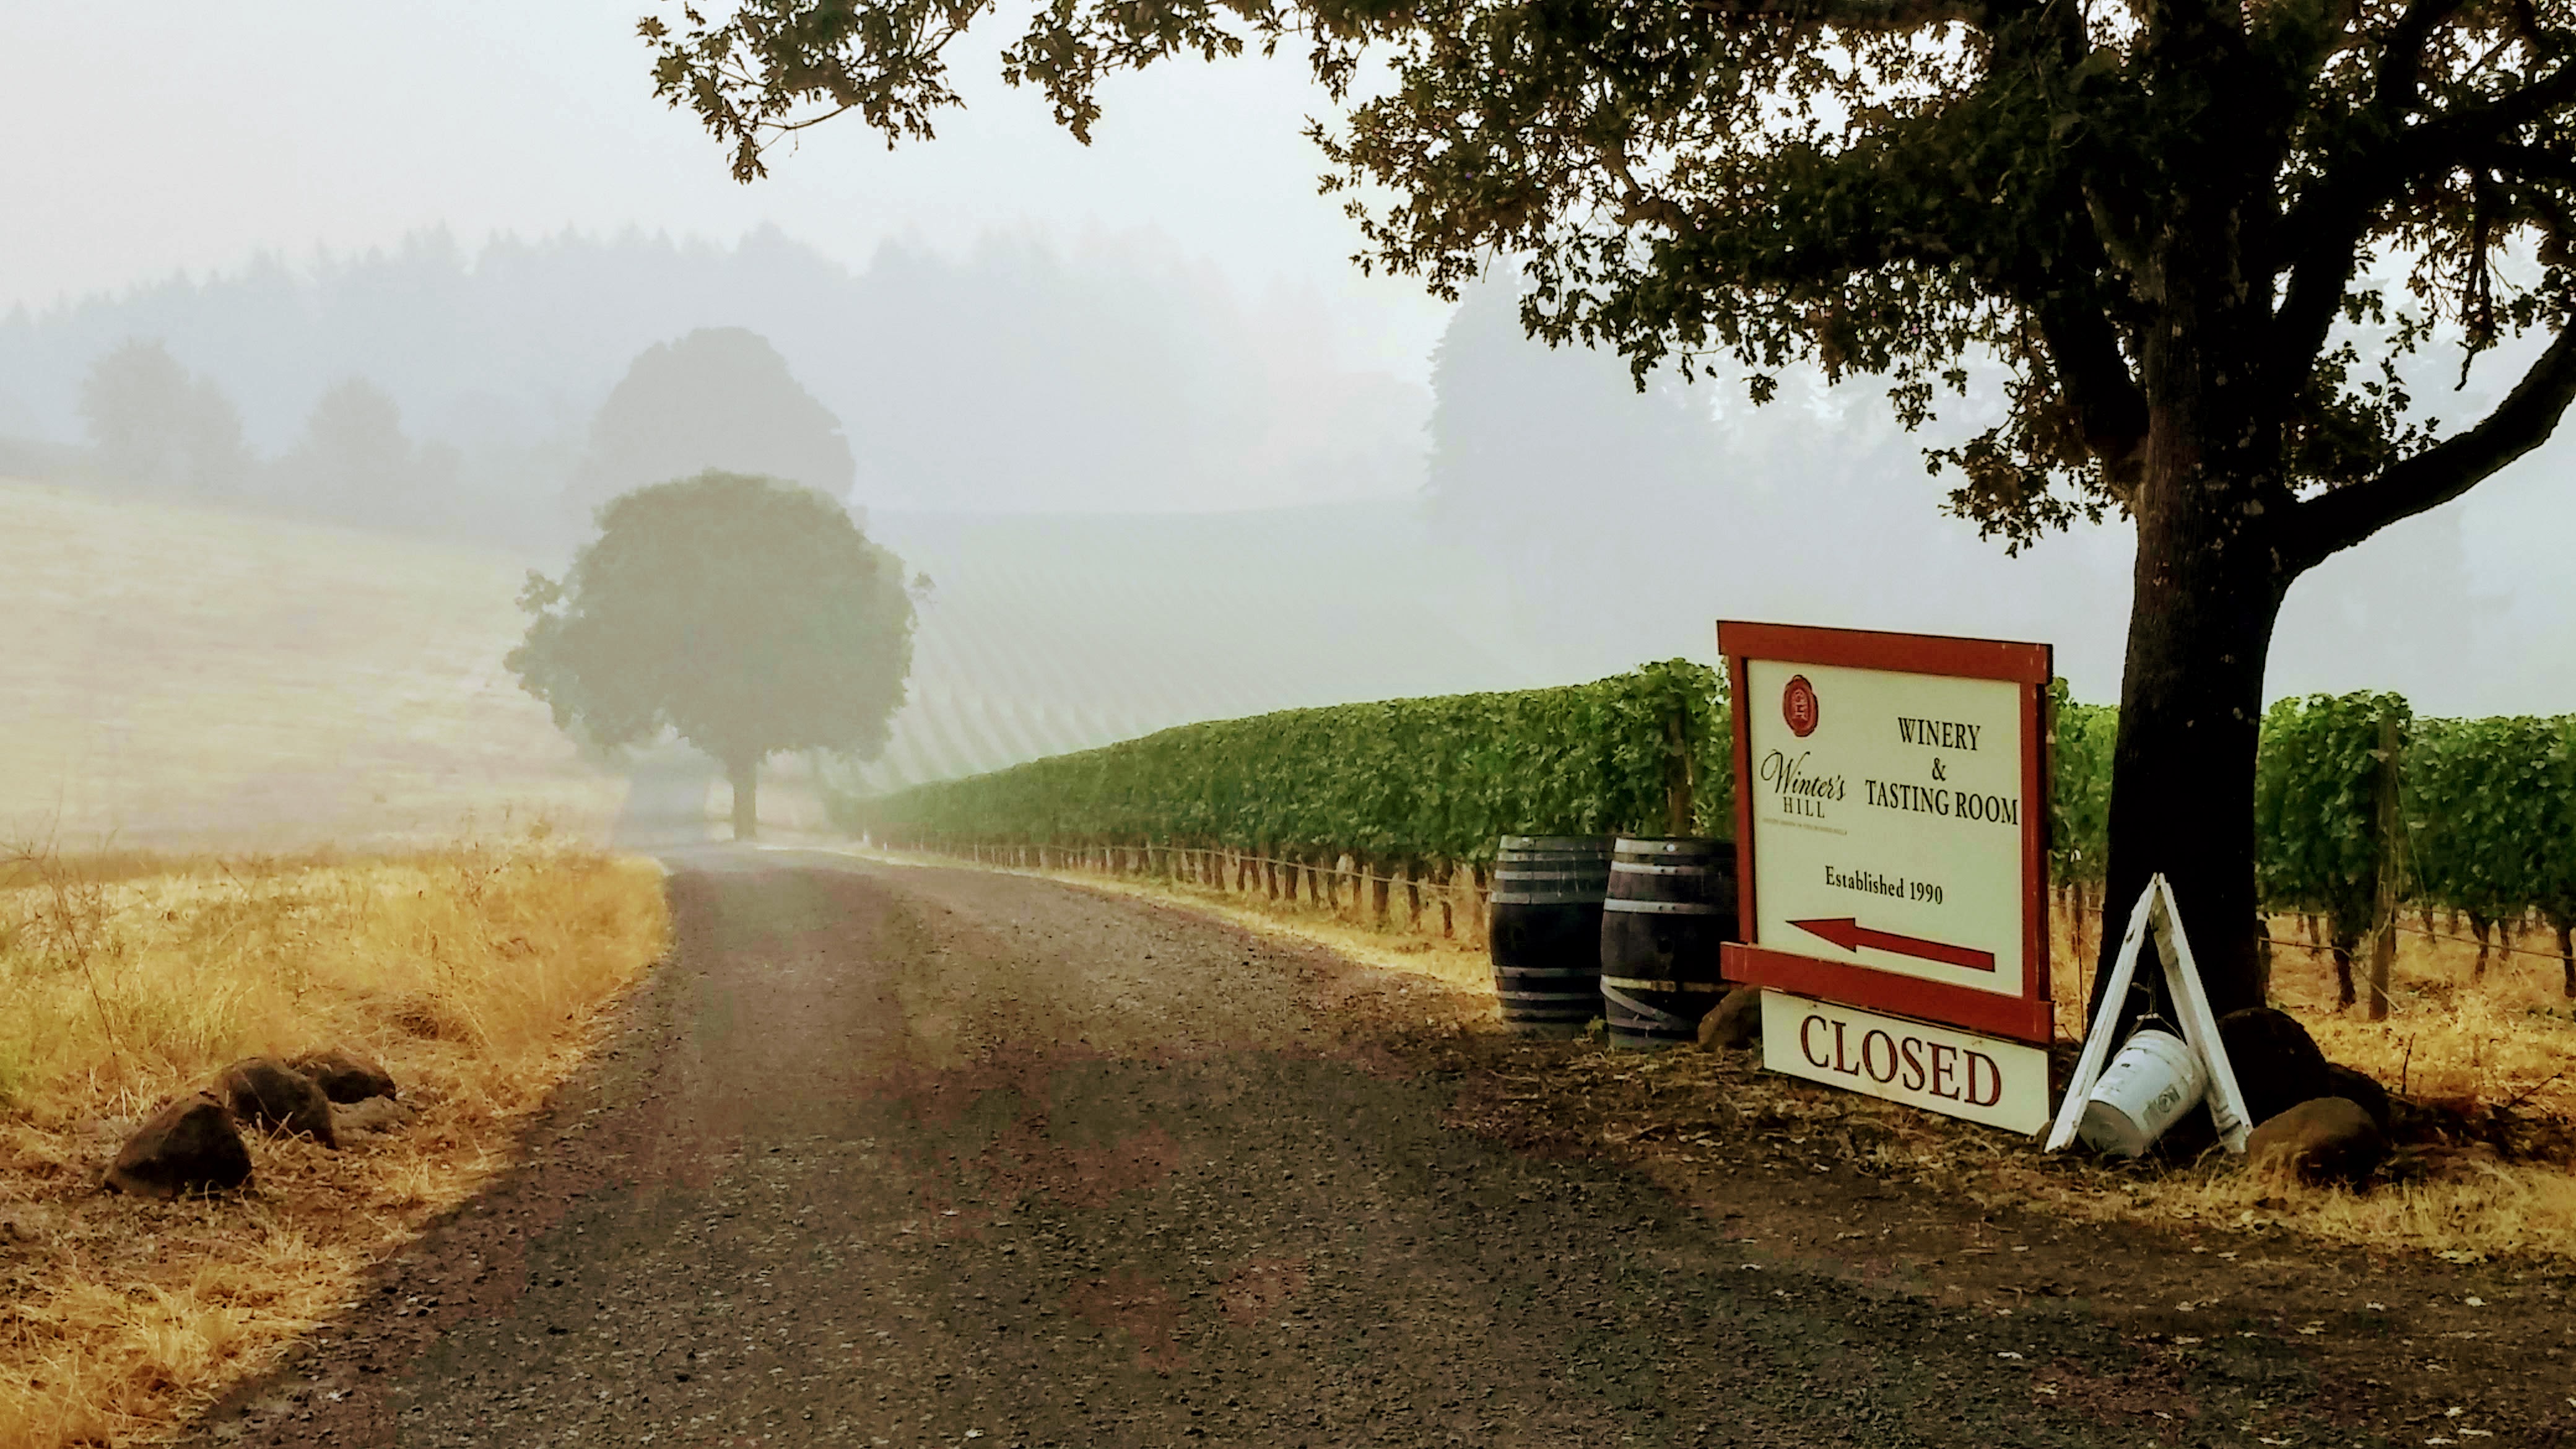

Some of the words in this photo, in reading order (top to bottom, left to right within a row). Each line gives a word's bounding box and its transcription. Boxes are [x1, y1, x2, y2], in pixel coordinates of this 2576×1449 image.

[1897, 716, 1981, 751] WINERY
[1760, 749, 1846, 801] Winter's
[1931, 757, 1946, 781] &
[1783, 796, 1825, 819] HILL
[1865, 779, 1949, 816] TASTING
[1954, 791, 2019, 825] ROOM
[1825, 865, 1905, 899] Established
[1910, 881, 1943, 905] 1990
[1800, 1014, 2002, 1107] CLOSED
